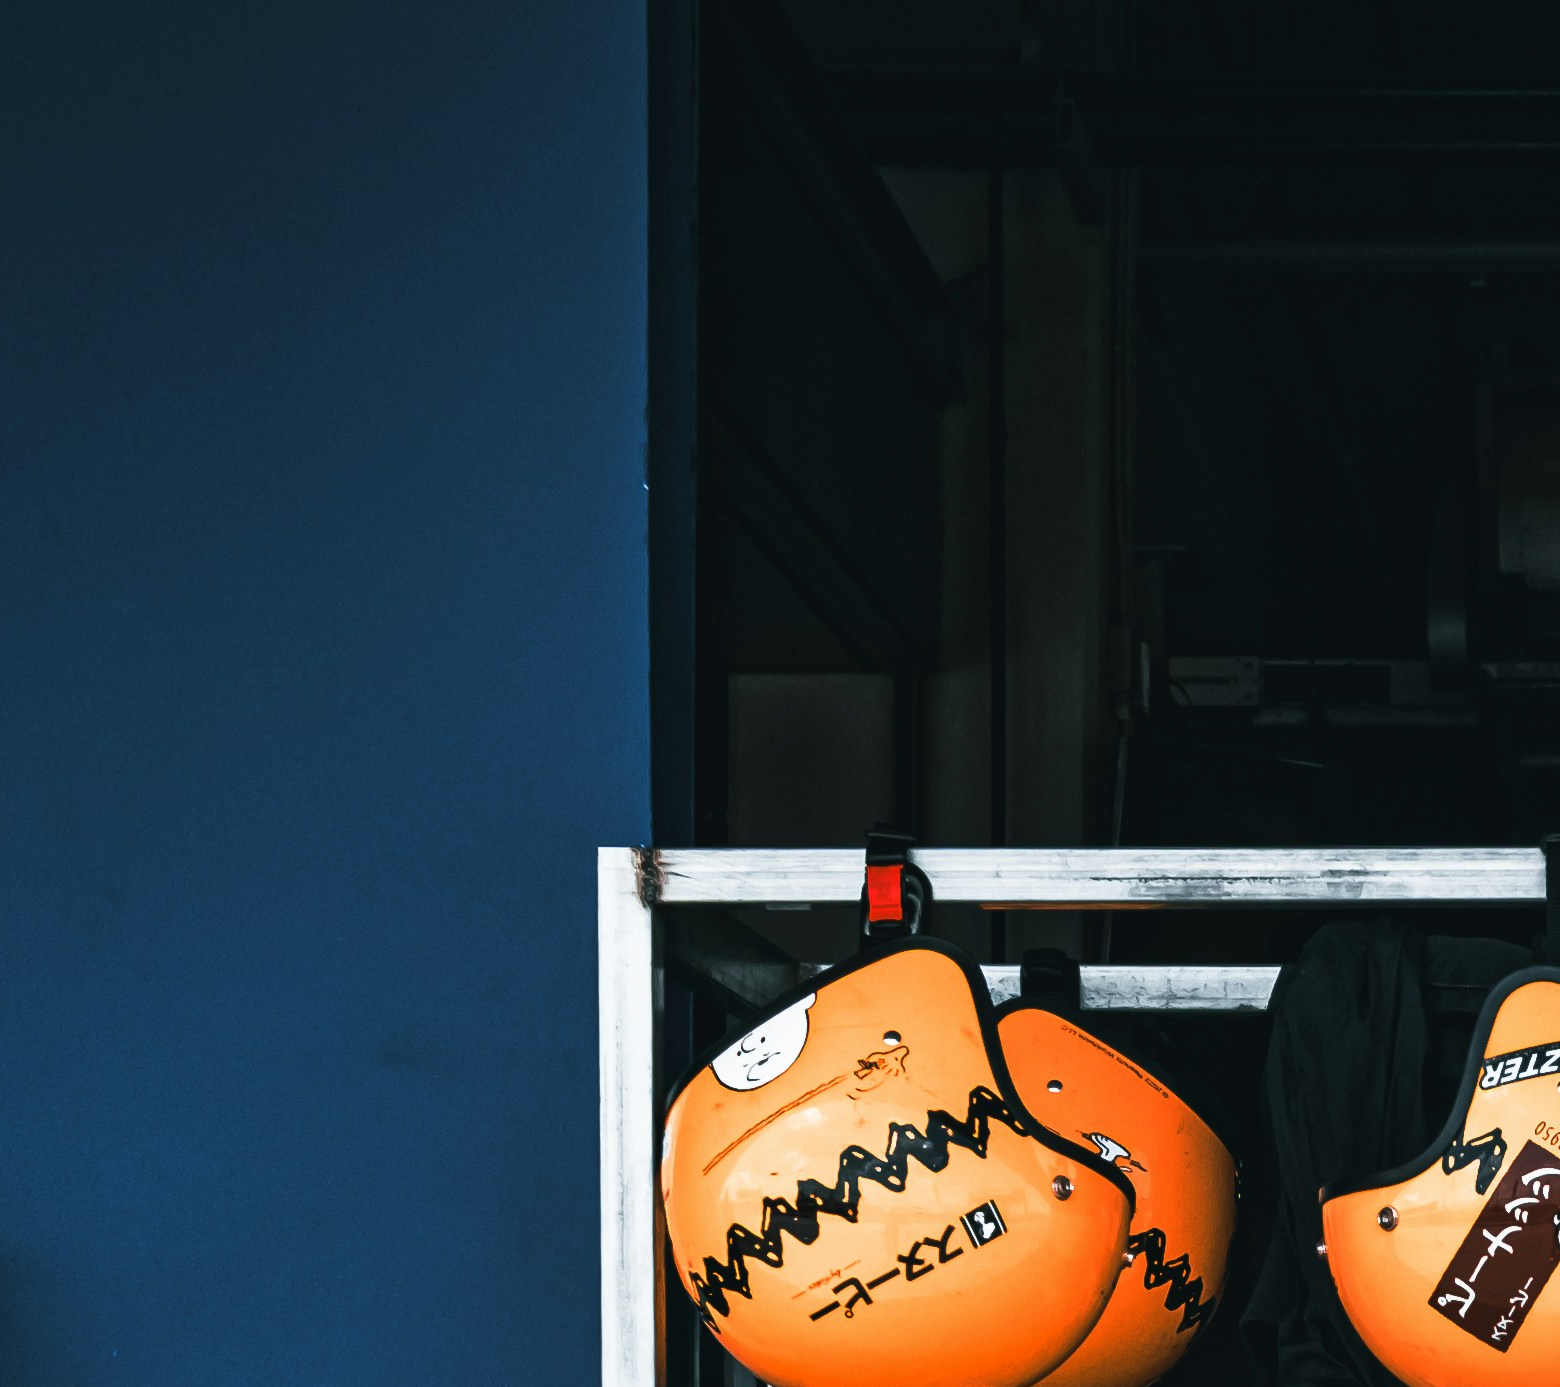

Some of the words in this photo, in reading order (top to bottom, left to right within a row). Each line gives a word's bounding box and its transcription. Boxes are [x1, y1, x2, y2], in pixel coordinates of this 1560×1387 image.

[808, 1224, 964, 1322] スヌーピー
